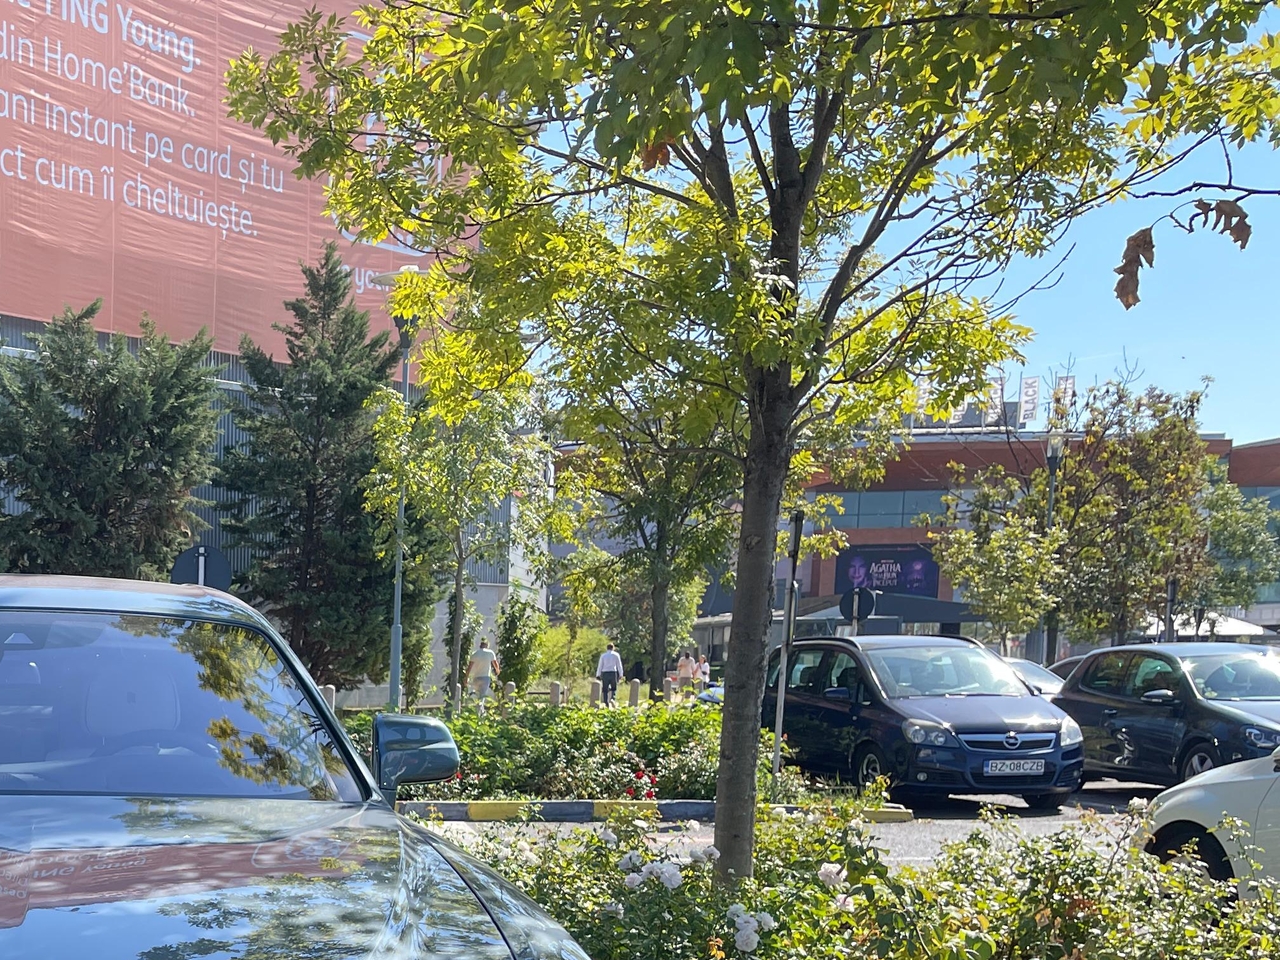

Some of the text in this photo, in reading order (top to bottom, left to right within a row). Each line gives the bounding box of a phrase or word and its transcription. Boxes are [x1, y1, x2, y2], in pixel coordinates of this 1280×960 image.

[116, 3, 201, 73] Young.
[46, 93, 136, 154] instant
[145, 131, 174, 168] pe
[181, 145, 231, 179] card
[238, 153, 255, 194] și
[261, 158, 284, 193] tu
[35, 157, 94, 196] cum
[100, 165, 115, 201] îi
[122, 173, 258, 240] cheltuiește.
[1022, 379, 1037, 420] BLACK
[869, 562, 902, 574] AGATHA
[990, 761, 1006, 772] BZ
